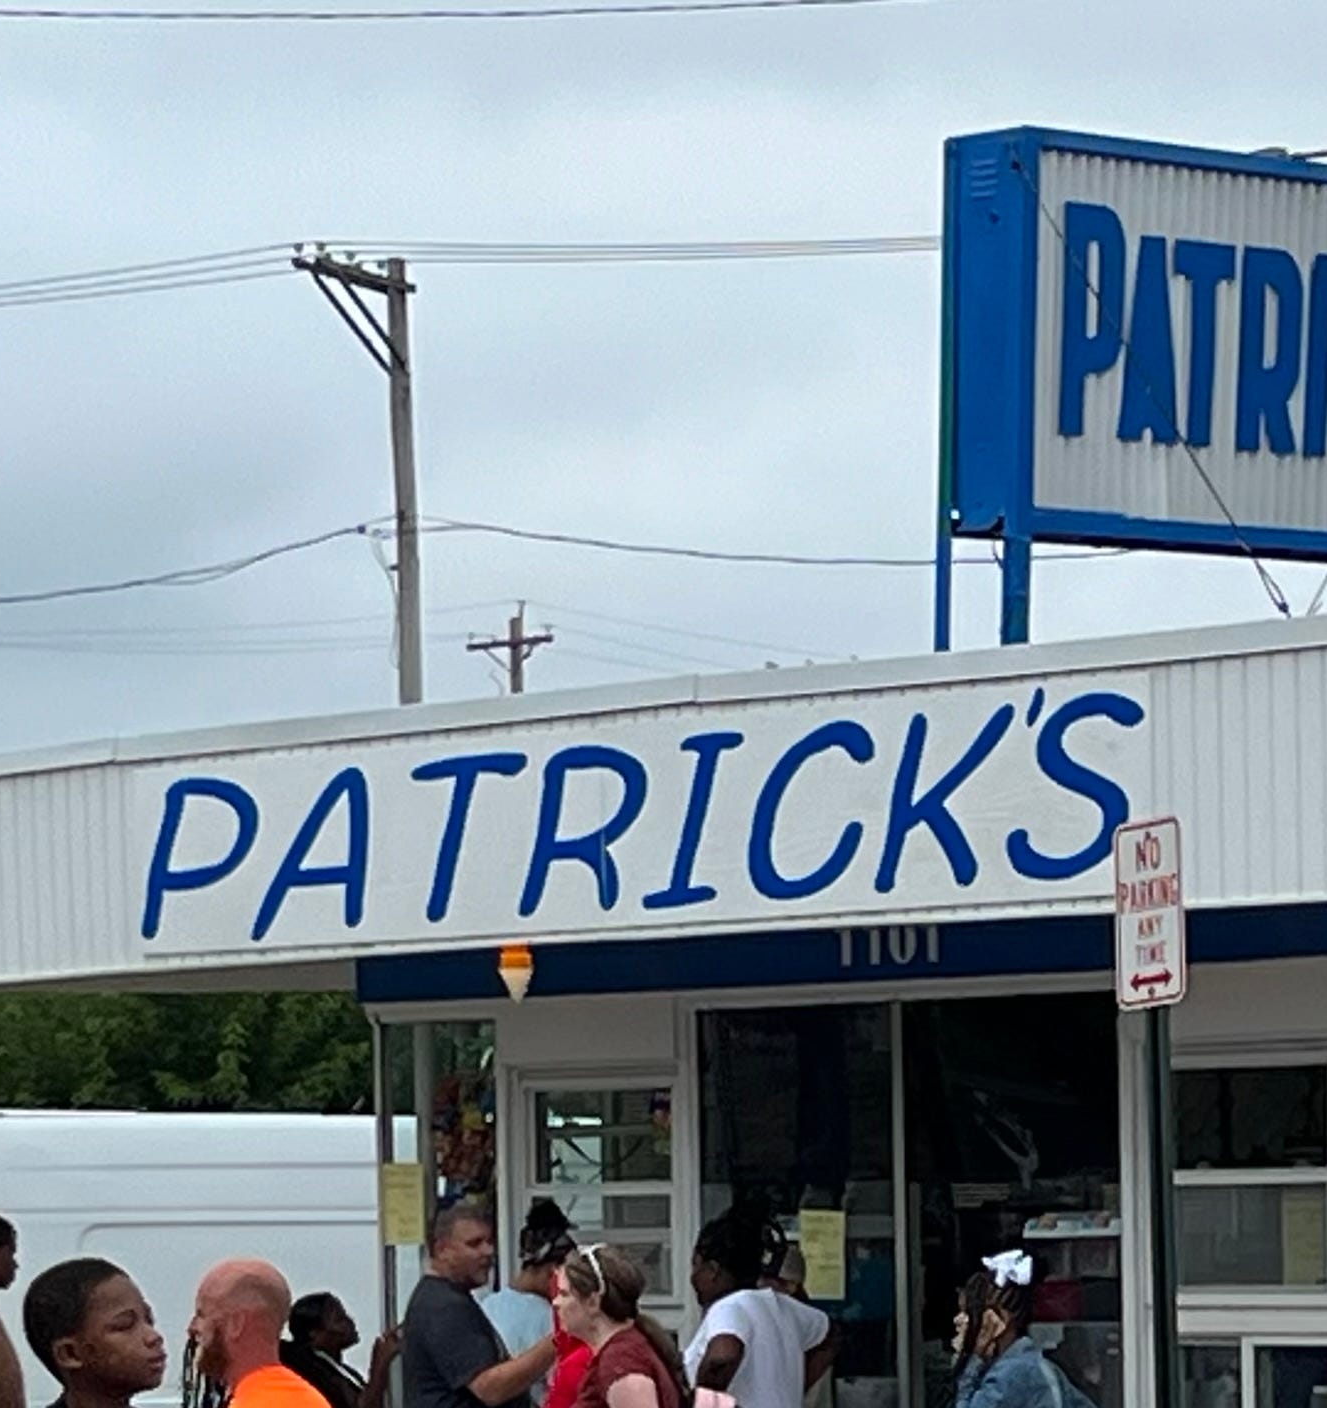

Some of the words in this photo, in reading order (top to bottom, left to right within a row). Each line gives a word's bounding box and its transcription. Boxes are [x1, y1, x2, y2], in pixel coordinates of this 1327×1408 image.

[141, 687, 1145, 942] PATRICK'S
[1135, 836, 1162, 873] NO
[1117, 873, 1178, 915] PARKING
[1137, 915, 1164, 940] ANY
[1135, 940, 1168, 968] TIME
